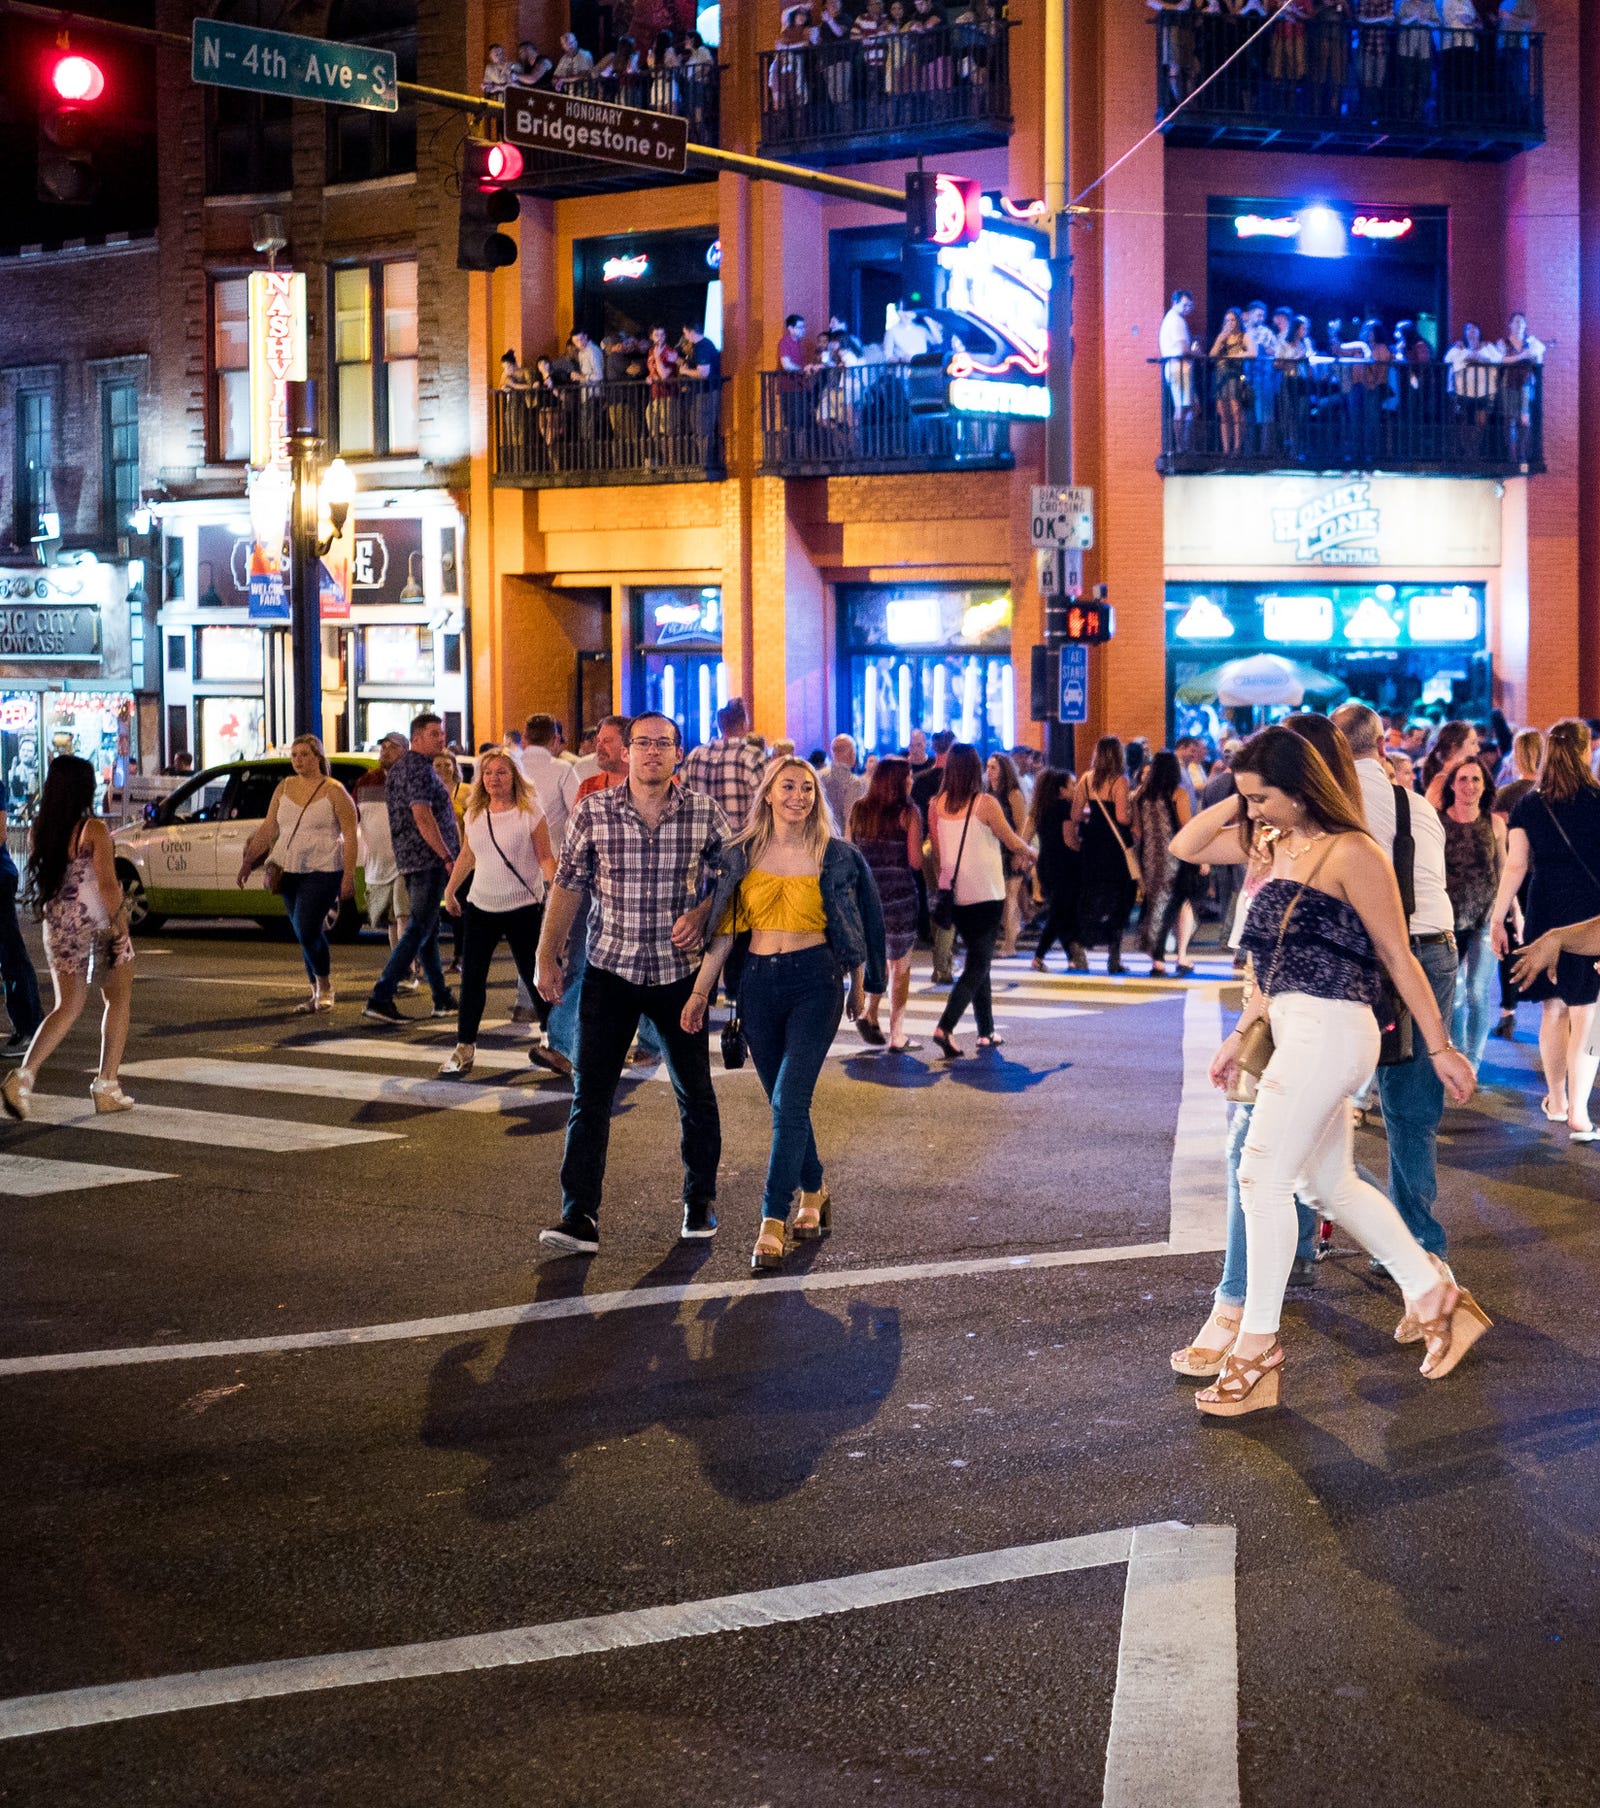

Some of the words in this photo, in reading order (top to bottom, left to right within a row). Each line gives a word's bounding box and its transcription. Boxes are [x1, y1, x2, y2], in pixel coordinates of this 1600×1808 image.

[203, 36, 287, 80] N-4th
[304, 53, 386, 95] Ave-S
[565, 101, 623, 126] HONORARY
[516, 110, 651, 156] Bridgestone
[655, 141, 676, 161] Dr
[264, 272, 293, 464] NASHVILLE
[1033, 517, 1057, 539] OK
[36, 609, 79, 635] CITY
[161, 840, 192, 854] Green
[166, 856, 187, 872] Cab
